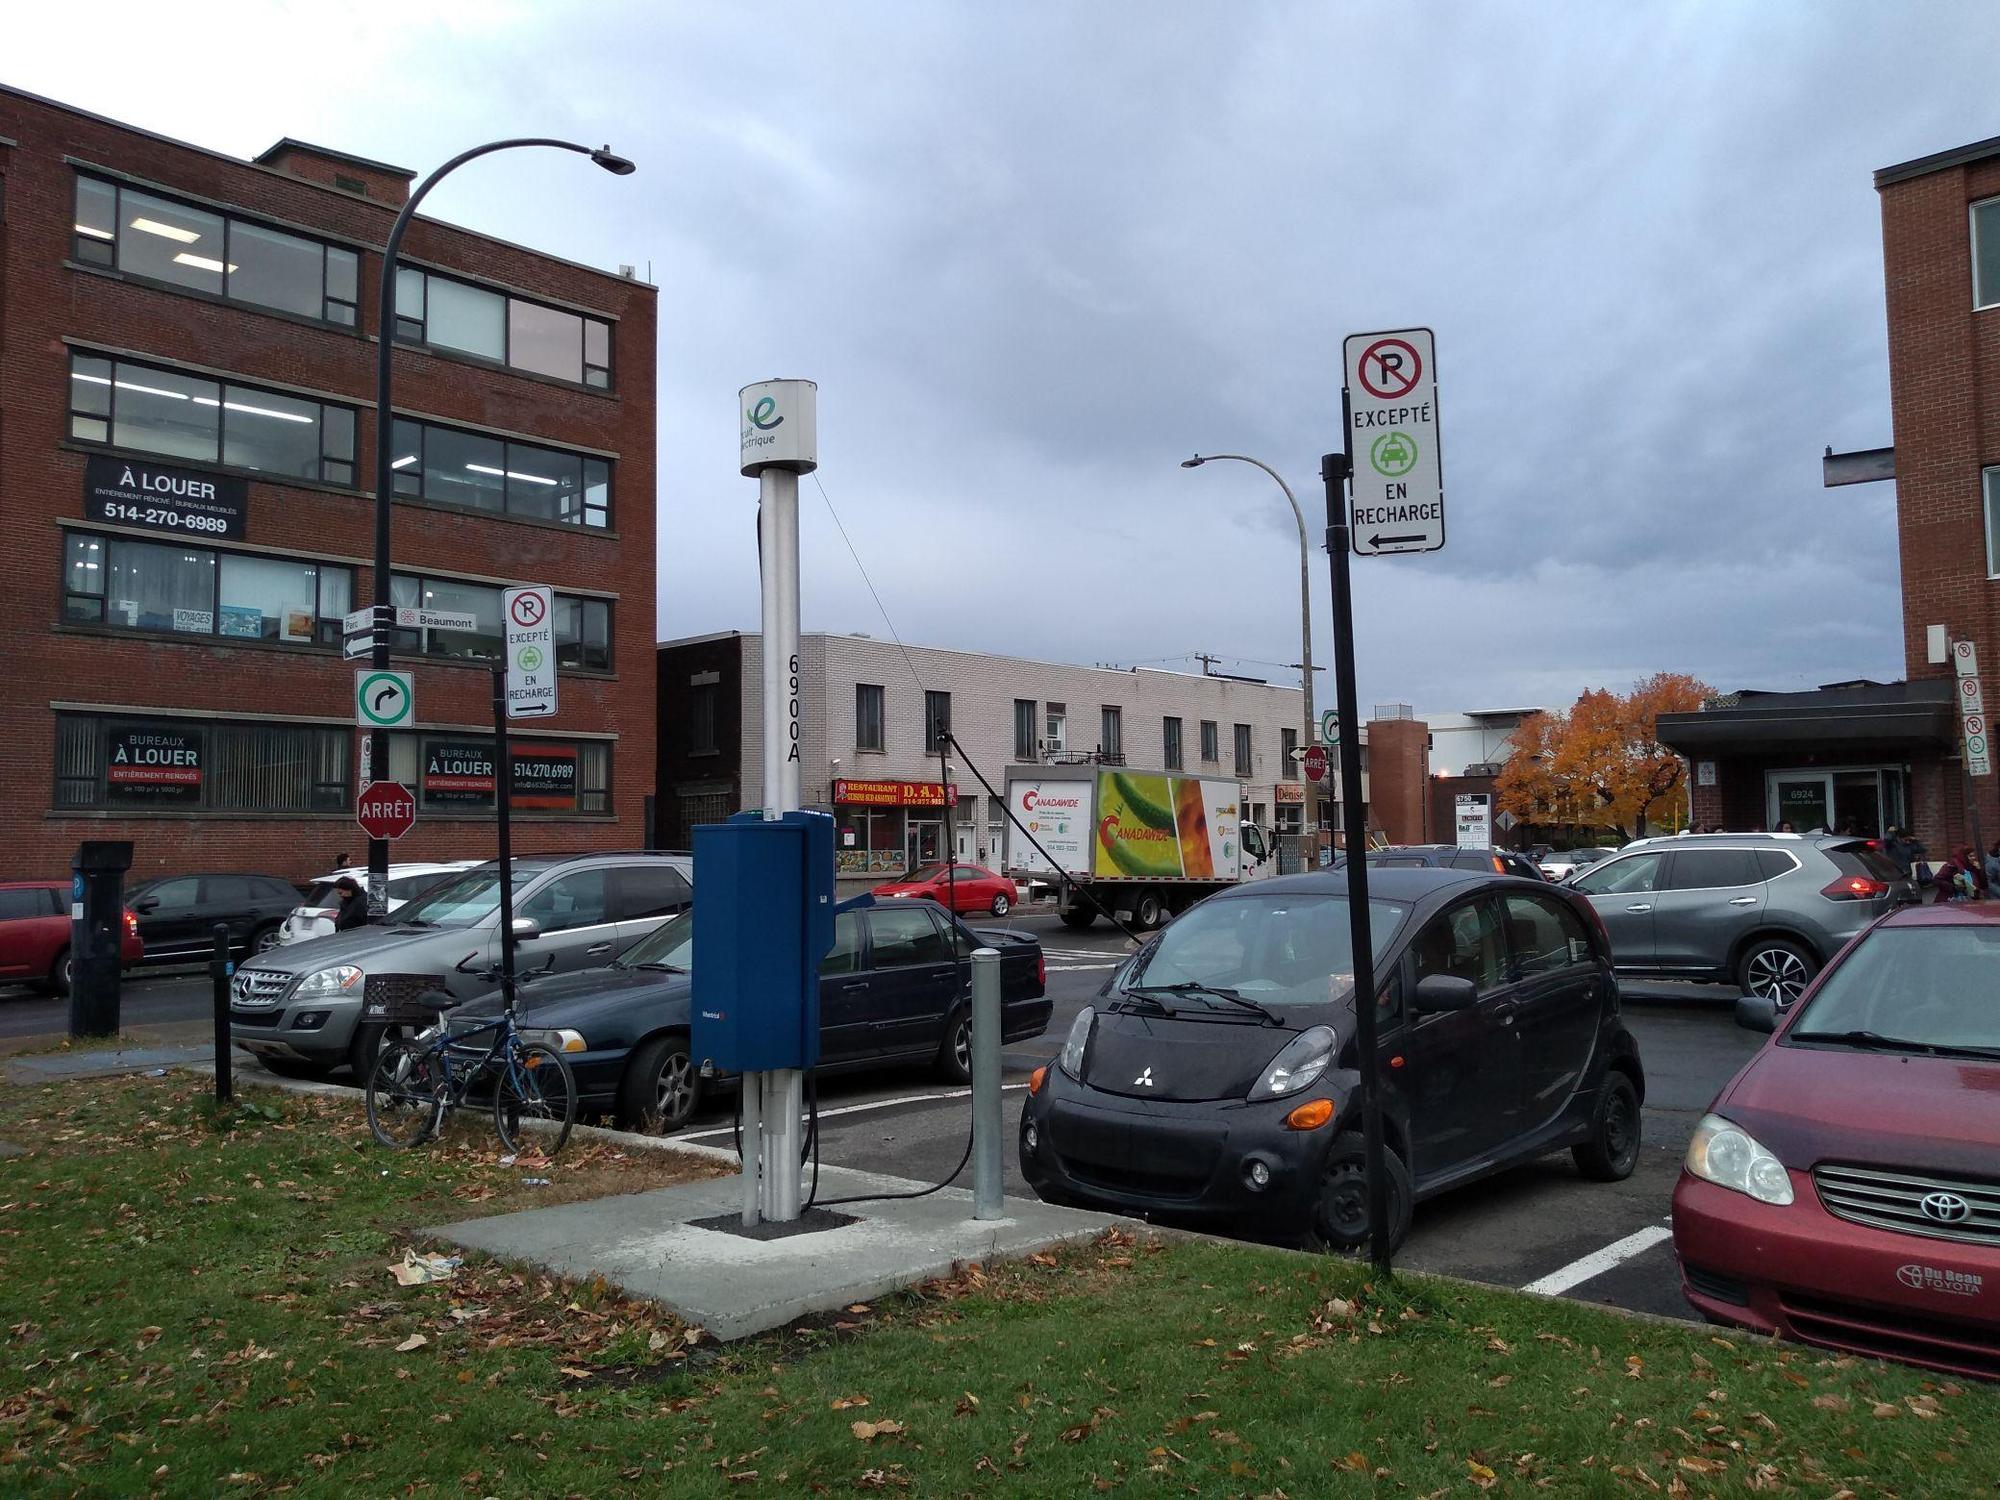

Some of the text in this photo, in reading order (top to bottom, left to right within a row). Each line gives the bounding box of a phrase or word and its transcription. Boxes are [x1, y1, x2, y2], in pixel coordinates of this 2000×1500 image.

[1354, 402, 1431, 428] EXCEPTÉ
[119, 465, 216, 500] À LOUER
[1386, 482, 1407, 500] EN
[104, 502, 227, 533] 514-270-6989
[1355, 502, 1440, 525] RECHARGE
[176, 610, 211, 624] VOYAGES
[419, 614, 473, 628] Beaumont
[345, 619, 358, 631] Parc
[509, 628, 549, 644] EXCEPTÉ
[525, 675, 537, 686] EN
[509, 686, 553, 701] RECHARGE
[787, 654, 801, 763] 6900A
[129, 734, 184, 747] BUREAUX
[114, 743, 197, 766] À LOUER
[440, 749, 482, 760] BUREAUX
[429, 756, 493, 776] À LOUER
[514, 762, 574, 778] 514.270.6989
[1305, 756, 1326, 770] ARRÊT
[847, 783, 898, 793] RESTAURANT
[1790, 790, 1814, 799] 6924
[361, 799, 413, 819] ARRÊT
[1924, 1278, 1980, 1293] TOYOTA
